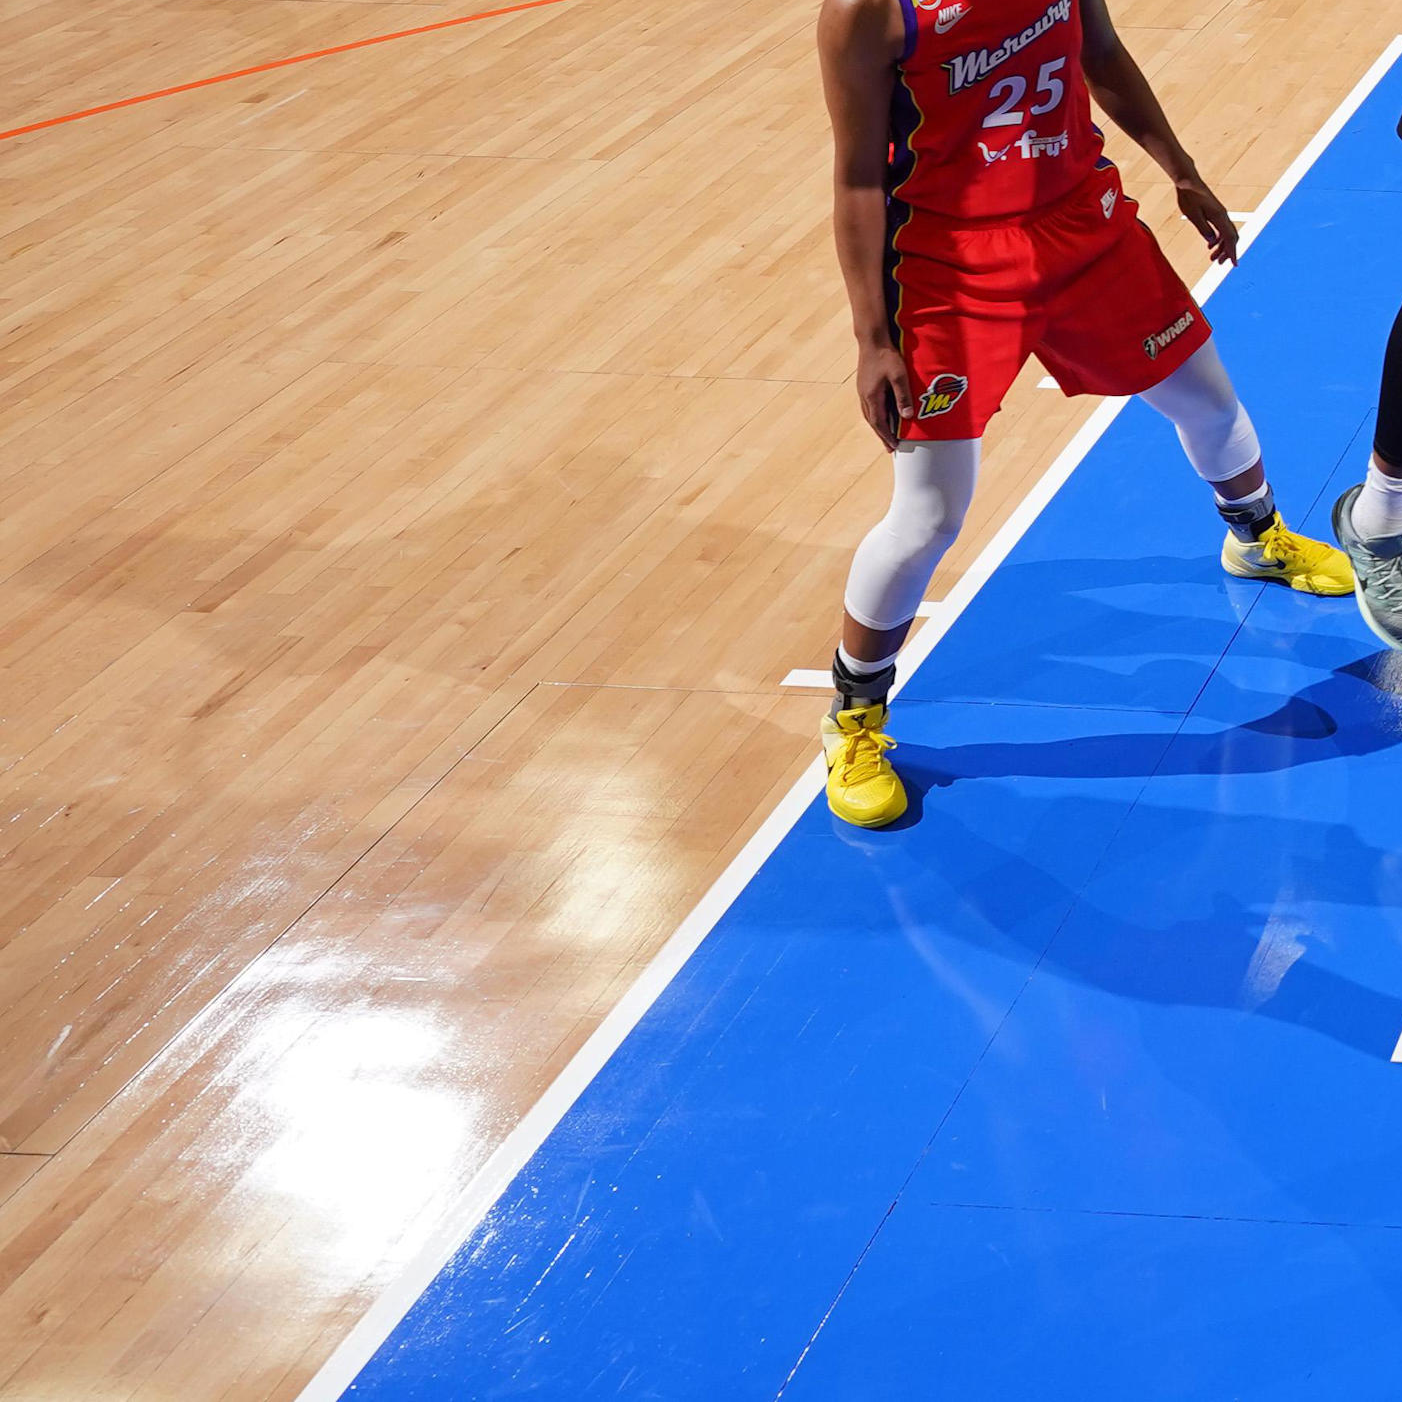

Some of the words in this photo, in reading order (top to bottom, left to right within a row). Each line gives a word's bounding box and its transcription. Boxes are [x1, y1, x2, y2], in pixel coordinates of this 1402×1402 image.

[937, 3, 963, 24] NIKE
[981, 56, 1067, 129] 25
[1158, 310, 1196, 349] WNBA
